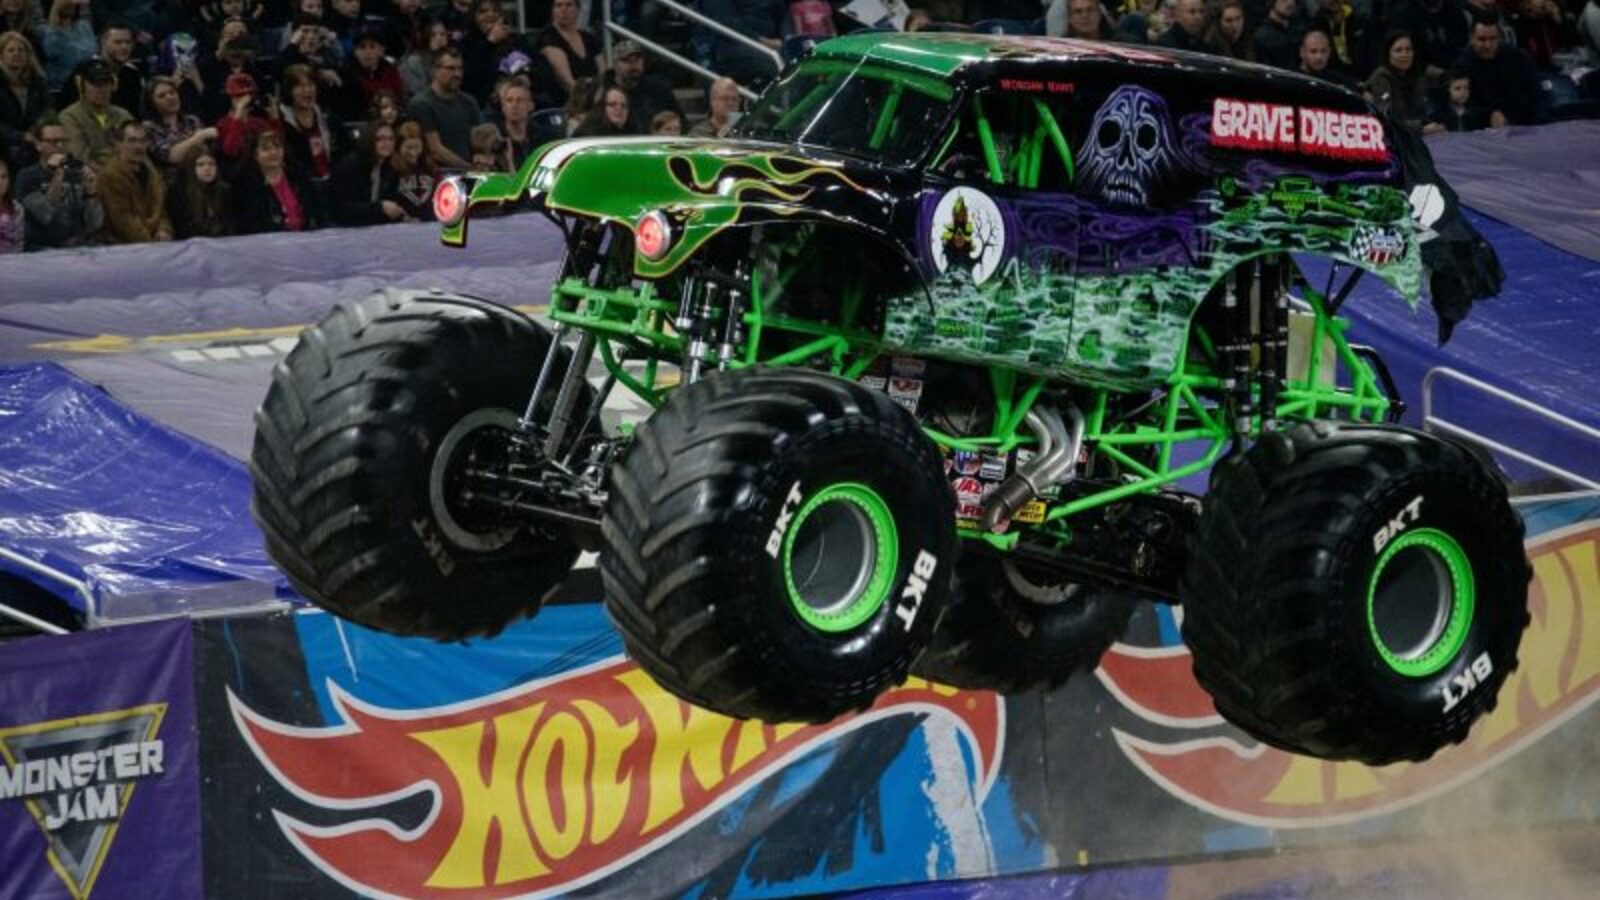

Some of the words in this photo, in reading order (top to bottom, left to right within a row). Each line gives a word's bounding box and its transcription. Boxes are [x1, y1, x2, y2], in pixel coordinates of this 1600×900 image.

[1212, 98, 1295, 144] GRAVE
[1300, 107, 1387, 152] DIGGER
[765, 481, 802, 559] BKT
[1372, 495, 1424, 555] BKT
[895, 548, 938, 633] BKT
[1442, 651, 1494, 714] BKT
[0, 740, 165, 799] MONSTER
[45, 773, 119, 830] JAM
